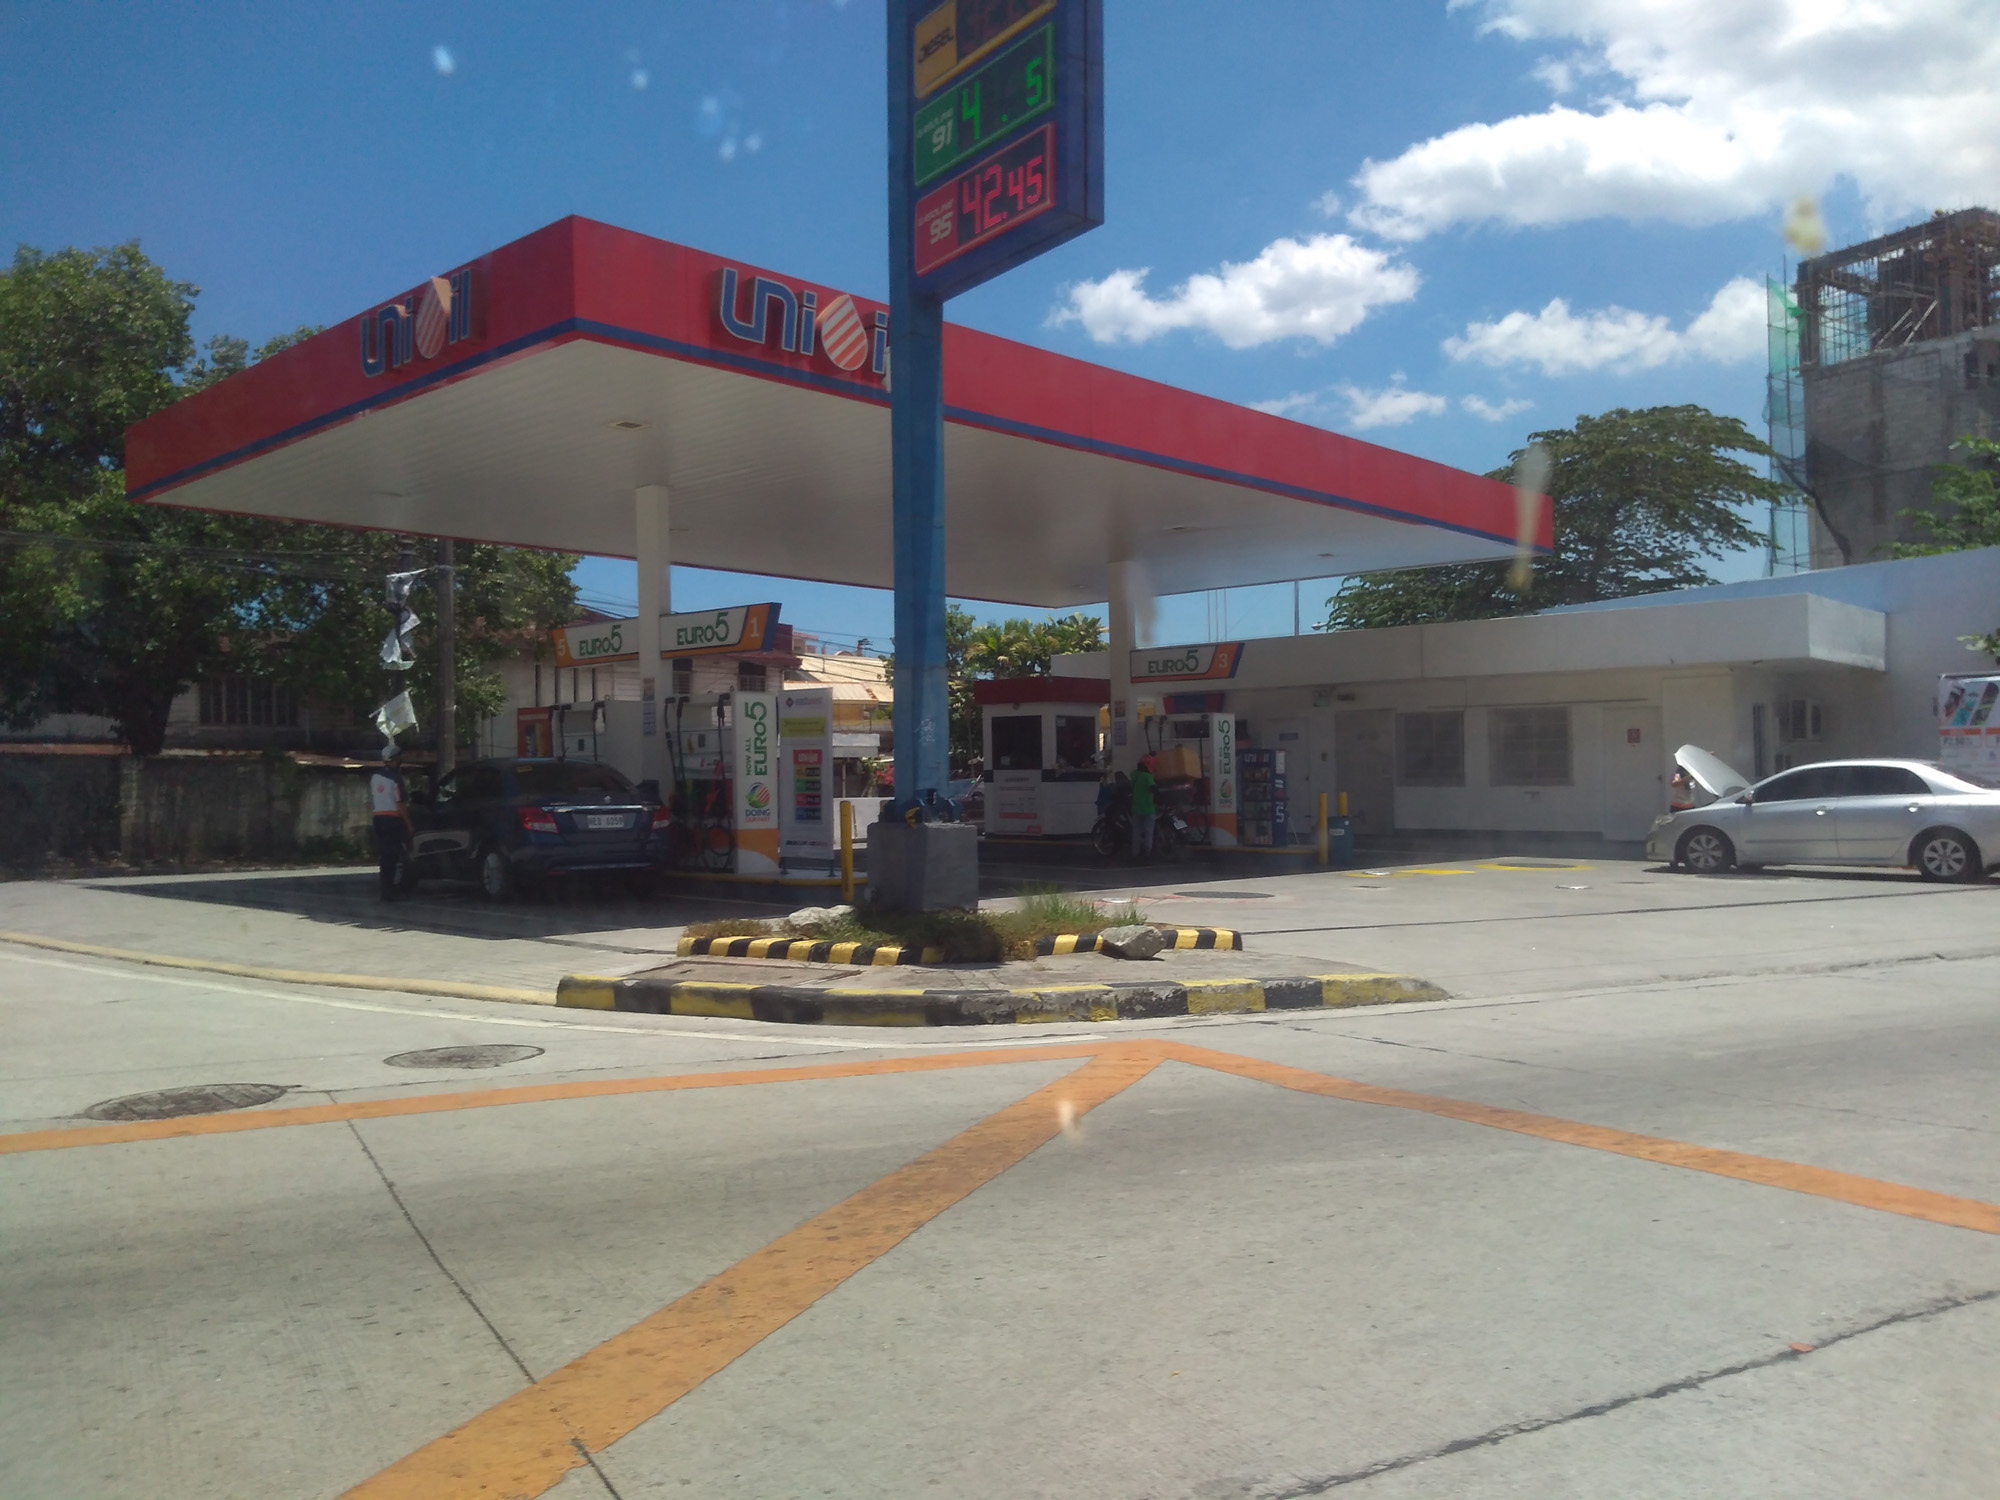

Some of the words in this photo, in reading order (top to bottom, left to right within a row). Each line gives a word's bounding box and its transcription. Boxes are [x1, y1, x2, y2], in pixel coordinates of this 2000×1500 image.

[931, 119, 953, 154] 91
[930, 210, 953, 245] 95
[750, 617, 760, 638] 1
[1218, 653, 1228, 669] 3
[745, 808, 771, 817] DOING
